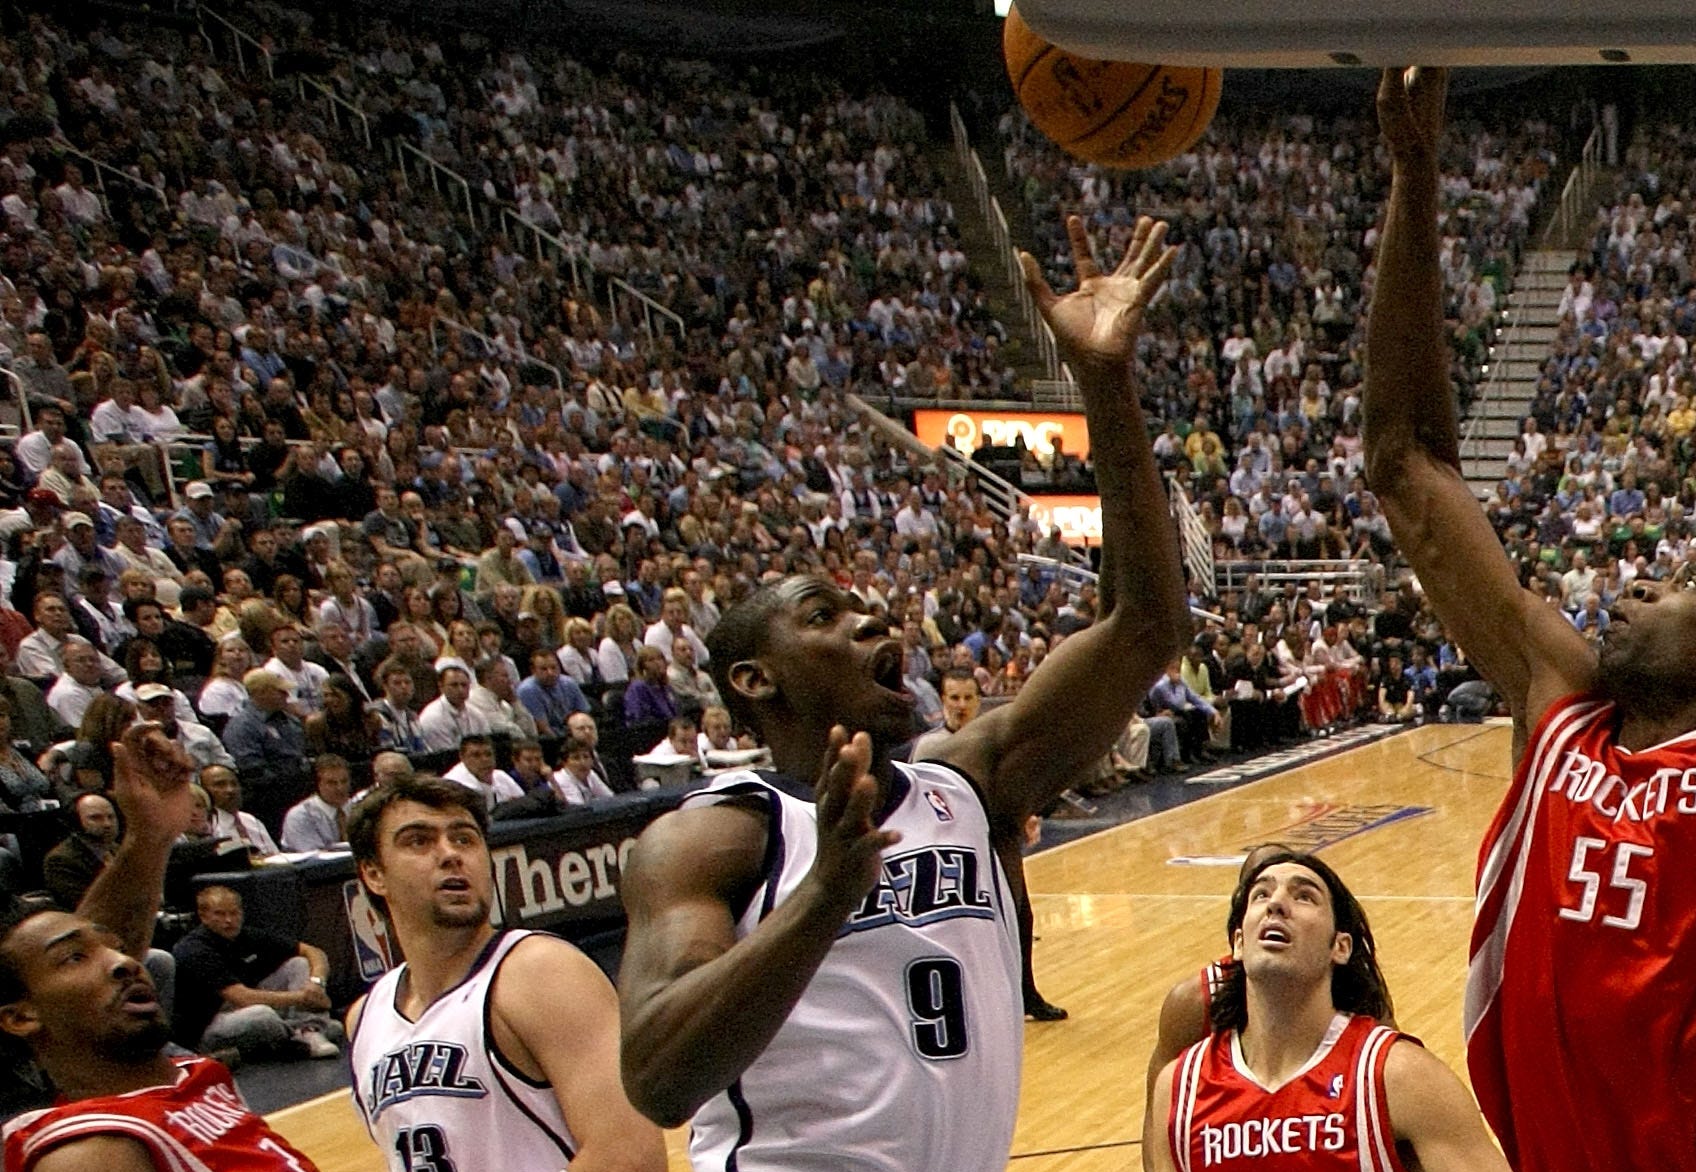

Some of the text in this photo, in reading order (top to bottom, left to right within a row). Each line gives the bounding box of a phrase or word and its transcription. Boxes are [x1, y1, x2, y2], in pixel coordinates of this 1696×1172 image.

[838, 846, 995, 934] AZZ
[1558, 835, 1654, 931] 55
[904, 955, 969, 1060] 9
[369, 1040, 489, 1124] JAZZ
[1200, 1113, 1346, 1168] ROCKETS
